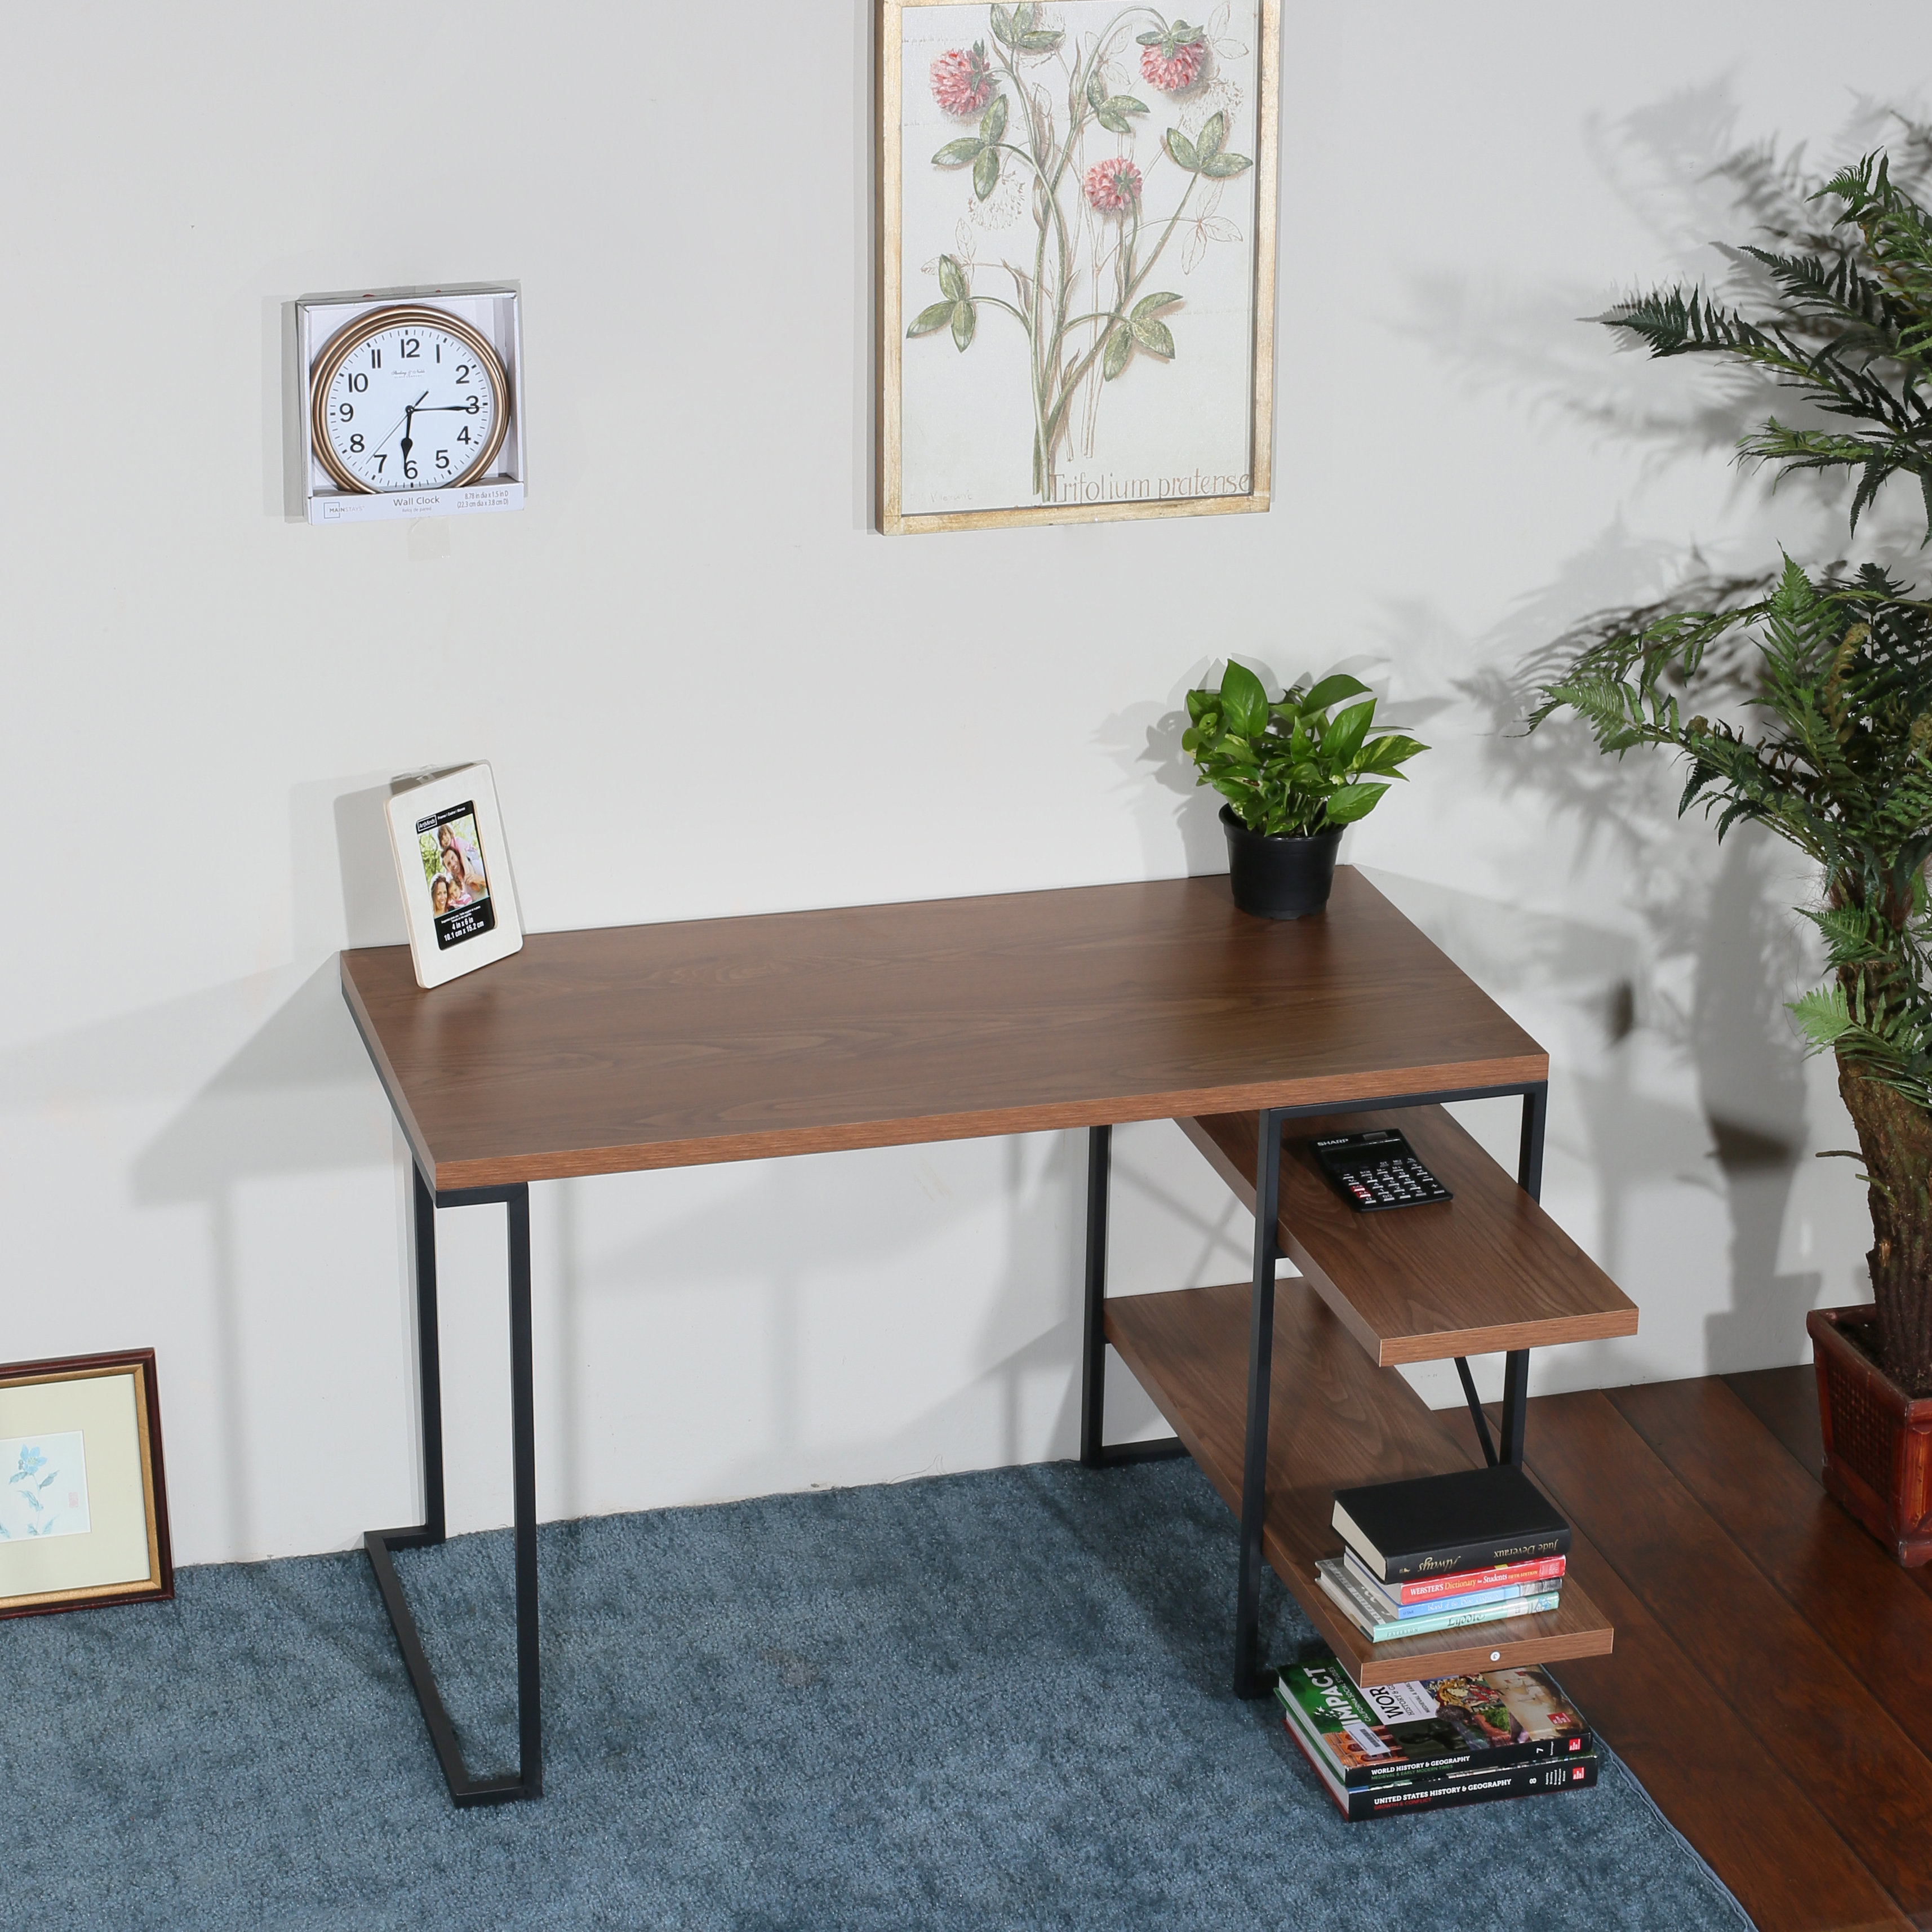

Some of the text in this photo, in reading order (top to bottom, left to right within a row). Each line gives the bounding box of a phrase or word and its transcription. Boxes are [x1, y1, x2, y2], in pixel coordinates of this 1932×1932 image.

[401, 338, 420, 358] 12
[436, 344, 440, 363] 1
[371, 349, 381, 368] 11
[348, 373, 368, 393] 10
[455, 365, 470, 384] 2
[339, 403, 354, 422] 9
[465, 396, 479, 414] 3
[350, 433, 365, 453] 8
[456, 426, 471, 445] 4
[374, 454, 387, 473] 7
[435, 450, 450, 469] 5
[405, 460, 418, 479] 6
[1050, 468, 1250, 503] Trifolium pratense
[393, 496, 440, 506] Wall Clock
[443, 932, 455, 941] 10.1
[466, 923, 477, 932] 15.2
[1494, 1539, 1558, 1558] Jude Deveraux
[1418, 1556, 1461, 1572] Always
[1410, 1584, 1444, 1596] WEBSTER'S
[1445, 1579, 1476, 1590] Dictionary
[1483, 1574, 1507, 1583] Students
[1428, 1602, 1442, 1611] Island
[1447, 1614, 1485, 1627] Lyddie
[1303, 1668, 1362, 1725] IMPACT
[1369, 1686, 1404, 1718] WOR
[1394, 1695, 1415, 1716] HISTORY
[1371, 1767, 1396, 1775] WORLD
[1396, 1763, 1424, 1771] HISTORY
[1431, 1756, 1471, 1766] GEOGRAPHY
[1374, 1796, 1402, 1805] UNITED
[1403, 1792, 1428, 1801] STATES
[1429, 1787, 1461, 1797] HISTORY
[1468, 1779, 1512, 1791] GEOGRAPHY
[1405, 1797, 1432, 1806] CONFLICT
